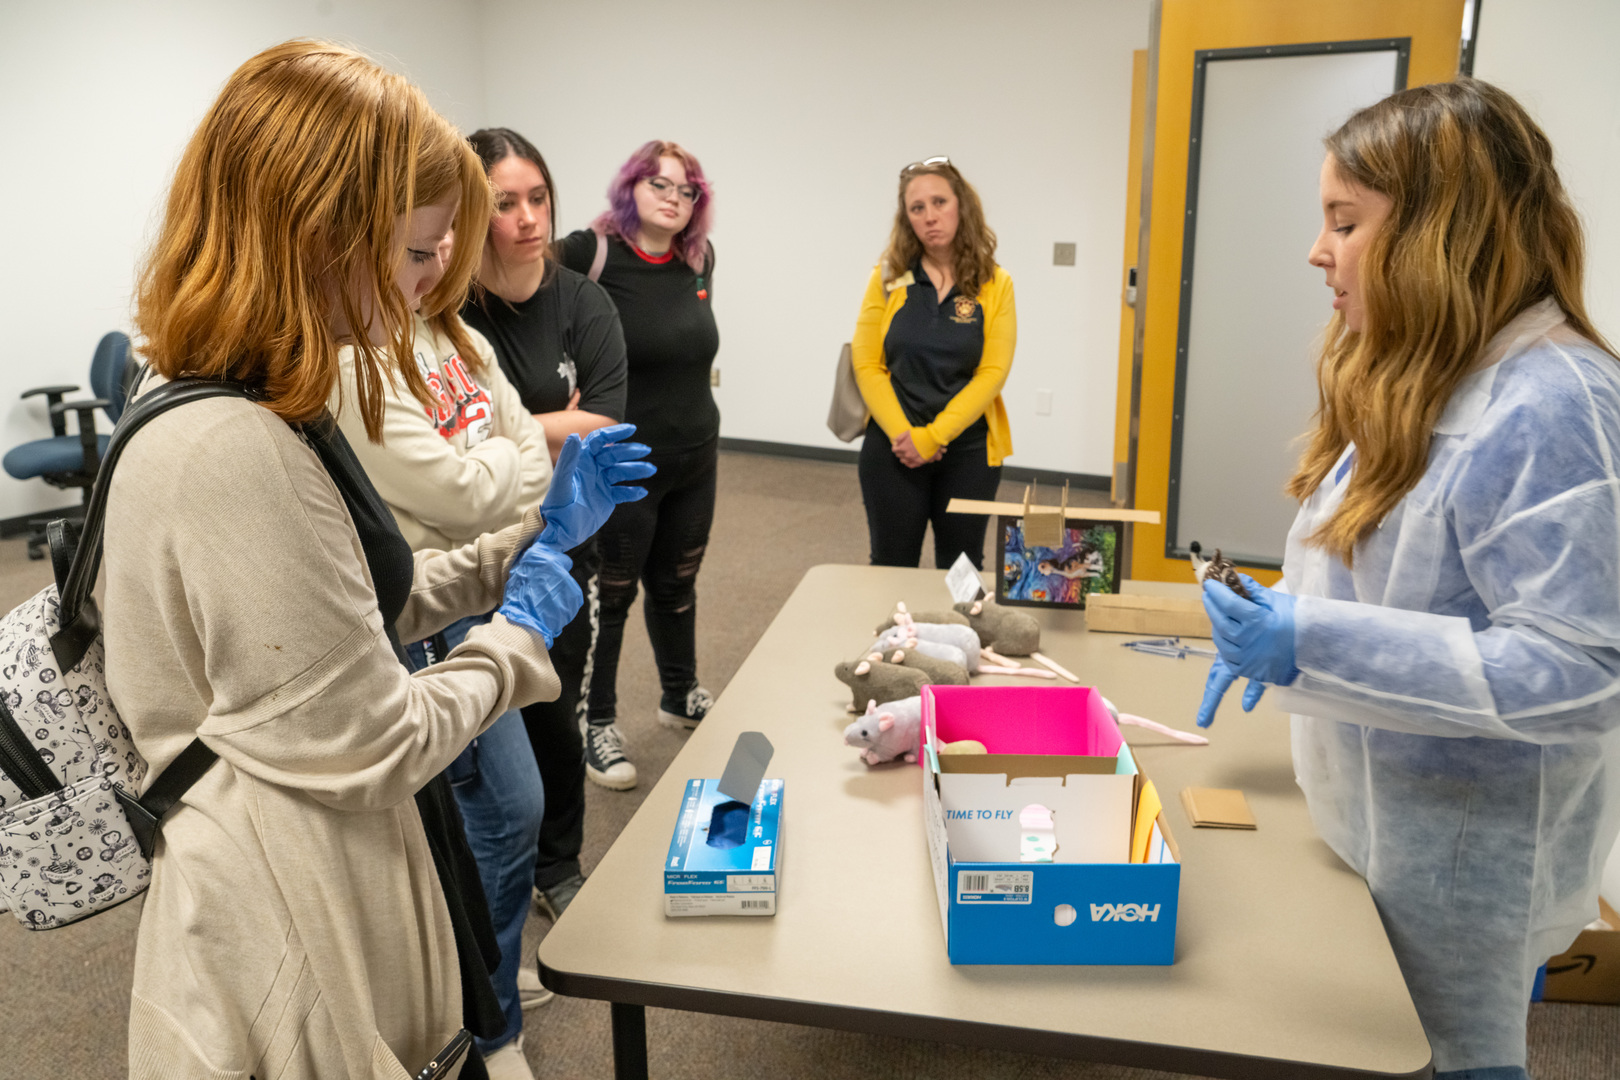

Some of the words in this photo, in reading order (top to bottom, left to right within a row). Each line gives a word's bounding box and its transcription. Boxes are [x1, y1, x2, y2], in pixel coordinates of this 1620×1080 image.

[946, 810, 973, 819] TIME
[976, 810, 992, 819] TO
[995, 810, 1013, 819] FLY
[1014, 883, 1030, 893] 8.5B
[1089, 903, 1161, 922] HOKA
